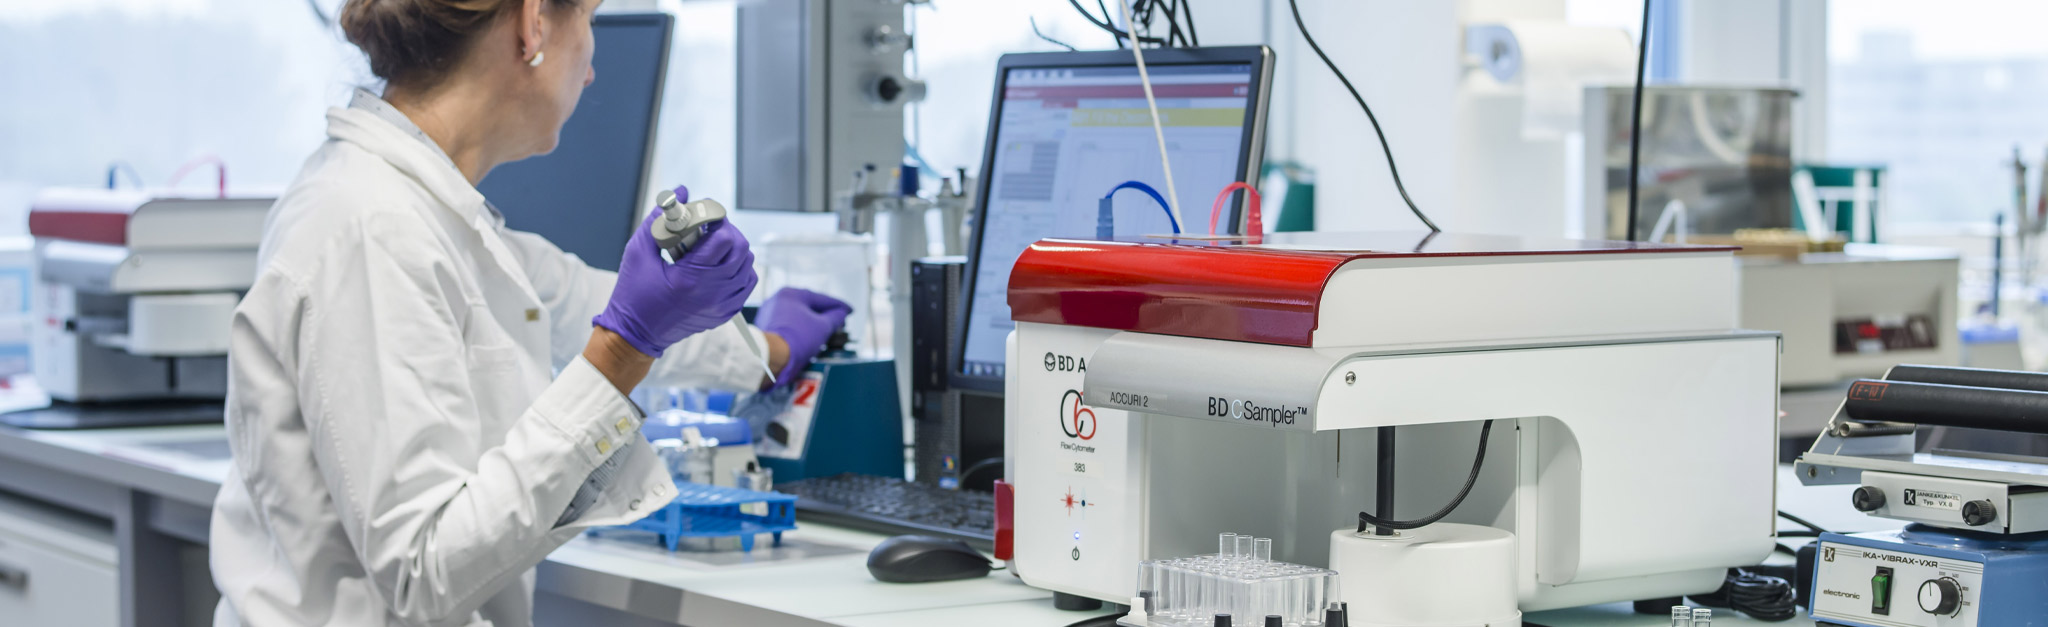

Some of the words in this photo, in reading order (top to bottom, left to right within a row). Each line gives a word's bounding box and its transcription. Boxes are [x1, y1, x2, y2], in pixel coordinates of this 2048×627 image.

[1057, 355, 1075, 372] BD
[1109, 391, 1142, 407] ACCURI
[1143, 395, 1149, 408] 2
[1207, 396, 1229, 417] BD
[1060, 442, 1072, 450] Flow
[1071, 443, 1096, 453] Cytometer
[1862, 551, 1938, 568] IKA-VIBRAX-VXR
[1823, 589, 1861, 600] electronic
